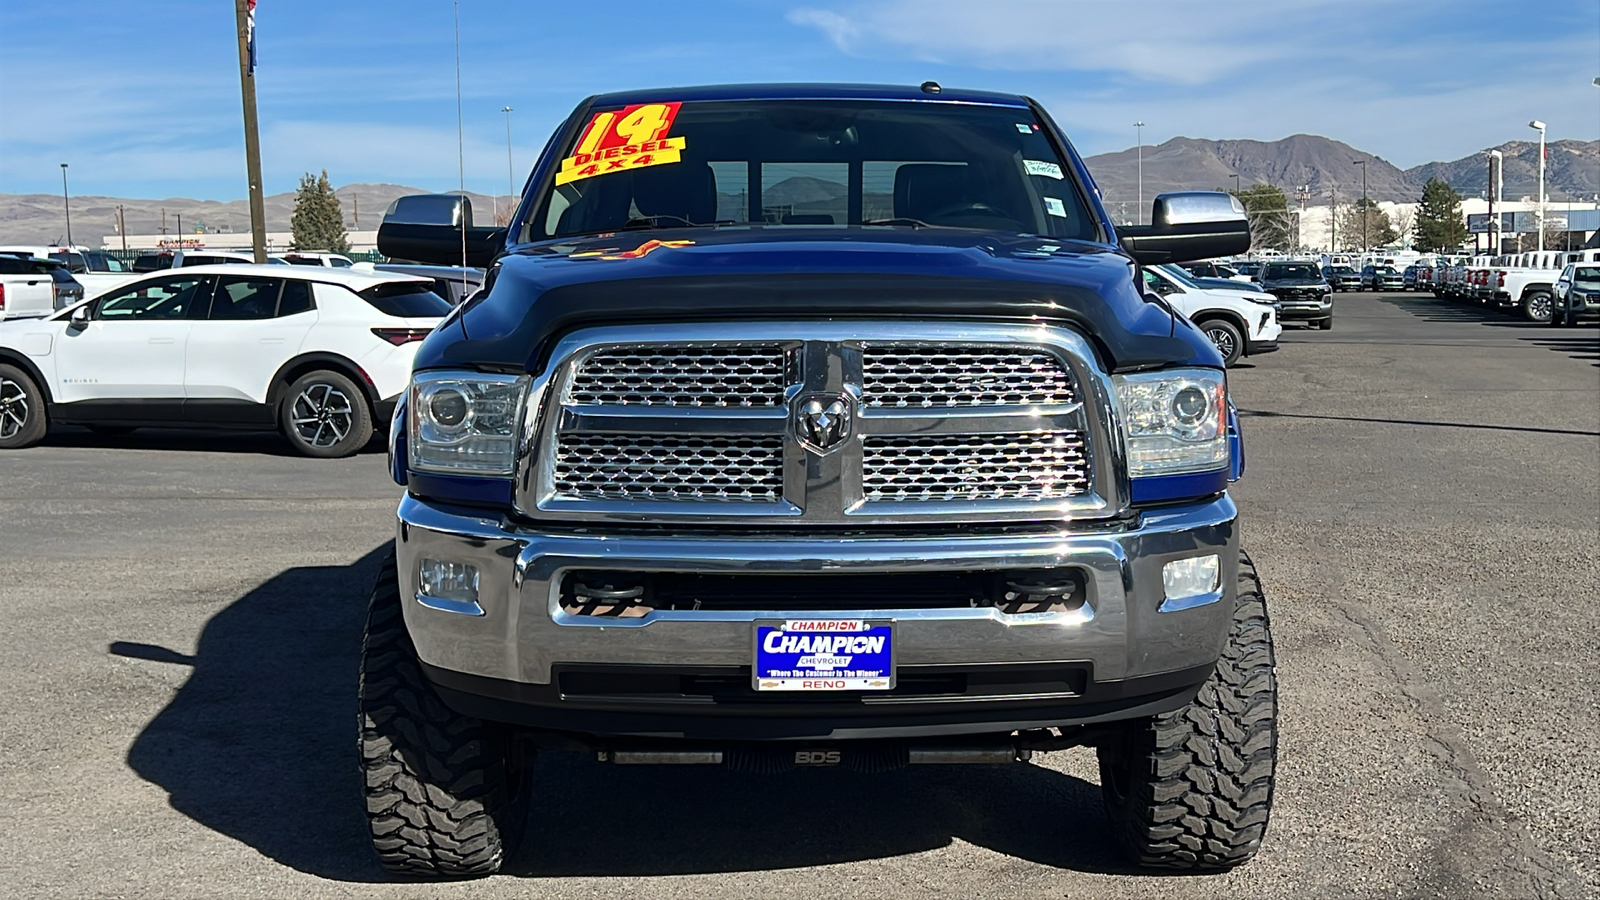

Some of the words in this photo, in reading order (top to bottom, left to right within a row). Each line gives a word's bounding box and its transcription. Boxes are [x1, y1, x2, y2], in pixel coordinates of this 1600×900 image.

[577, 104, 671, 154] 14
[574, 140, 674, 167] DIESEL
[791, 621, 857, 631] CHAMPION
[763, 631, 885, 653] CHAMPION
[800, 657, 848, 665] CHEVROLET
[802, 680, 845, 688] RENO
[795, 751, 841, 764] BDS
